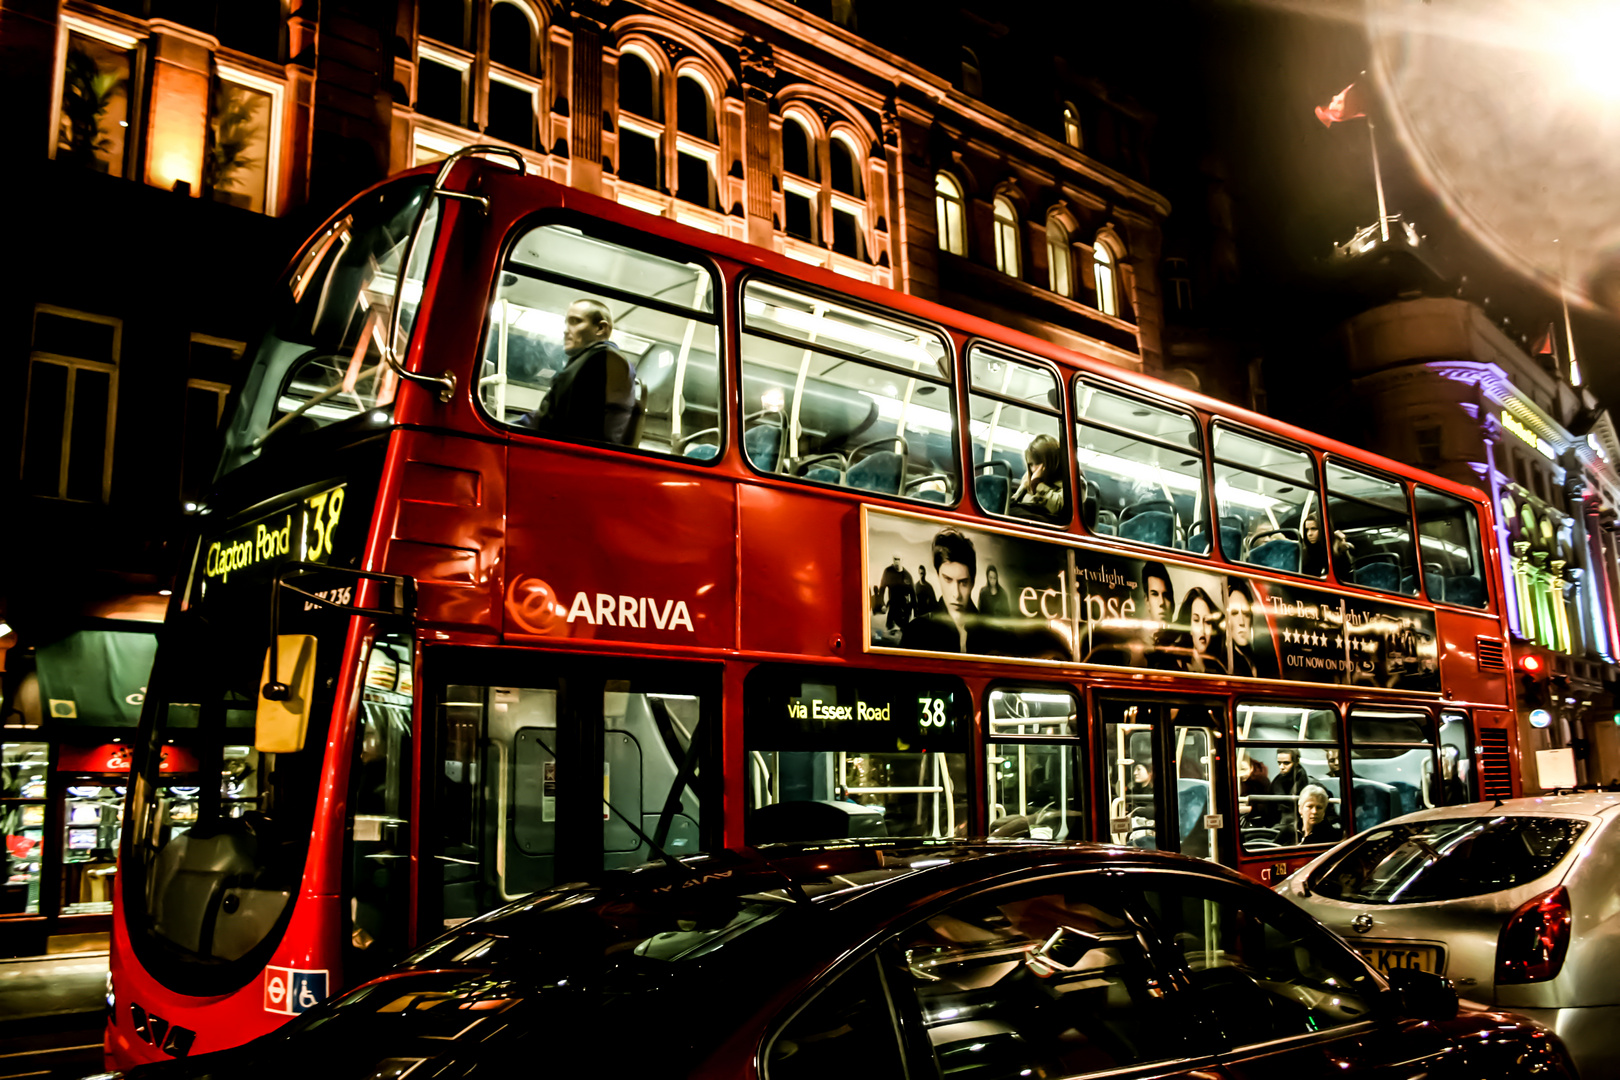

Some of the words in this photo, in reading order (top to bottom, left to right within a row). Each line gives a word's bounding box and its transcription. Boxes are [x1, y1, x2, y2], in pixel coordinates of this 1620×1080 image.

[308, 487, 345, 561] 38
[206, 539, 253, 583] Clapton
[255, 515, 291, 562] Pond
[1084, 564, 1125, 590] twilight
[566, 591, 695, 632] ARRIVA
[1019, 570, 1136, 653] eclipse
[1296, 600, 1320, 620] Best
[1287, 655, 1304, 667] OUT
[1305, 657, 1325, 669] NOW
[1325, 659, 1337, 670] ON
[788, 701, 808, 719] via
[812, 699, 853, 720] Essex
[857, 701, 890, 721] Road
[918, 698, 946, 728] 38
[1261, 868, 1271, 881] CT
